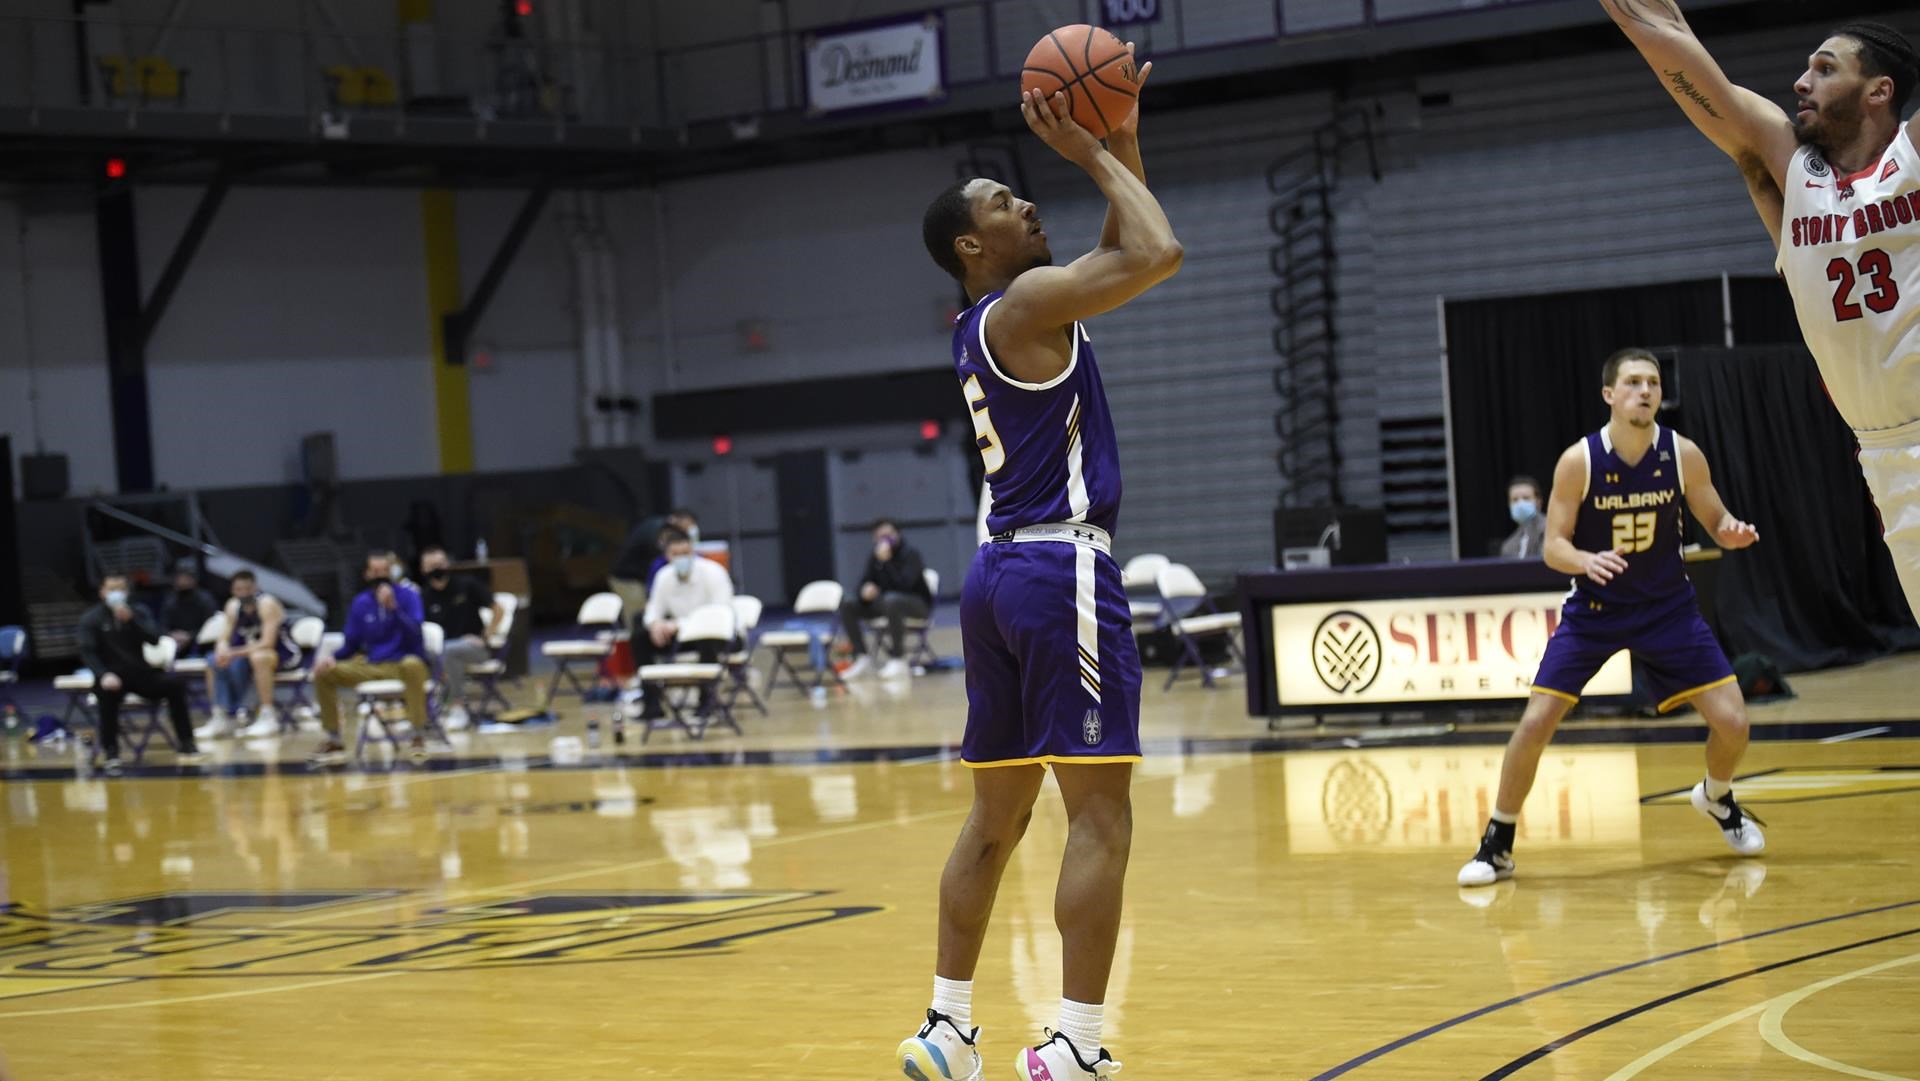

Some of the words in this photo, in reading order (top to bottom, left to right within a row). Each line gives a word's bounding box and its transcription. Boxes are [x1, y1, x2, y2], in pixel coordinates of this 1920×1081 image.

[1792, 214, 1850, 247] STONY
[1826, 248, 1899, 322] 23
[1594, 489, 1675, 510] UALBANY
[1612, 511, 1657, 554] 23
[1402, 677, 1532, 692] AREN
